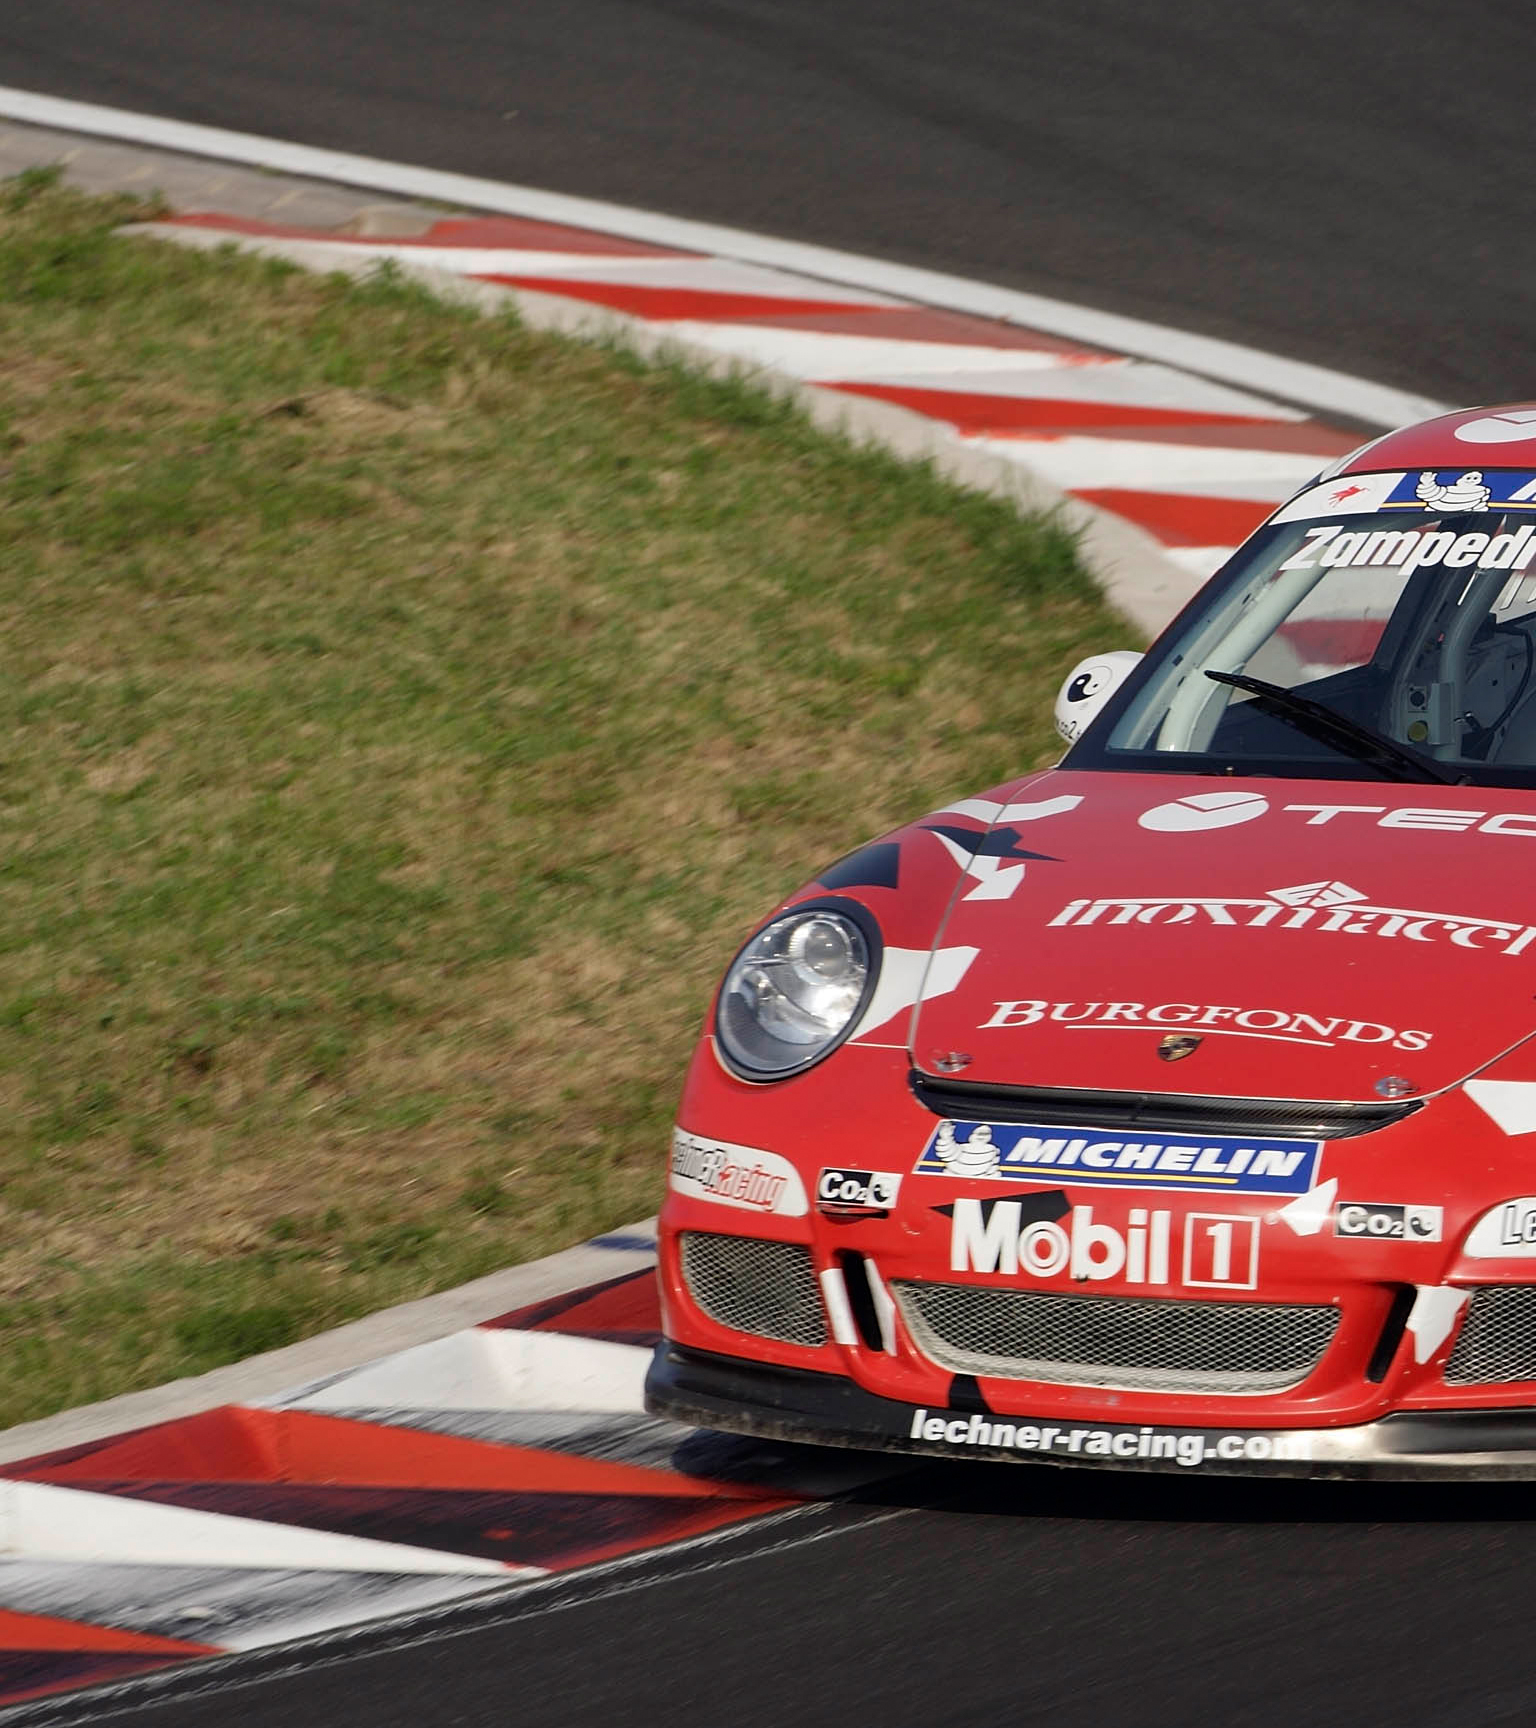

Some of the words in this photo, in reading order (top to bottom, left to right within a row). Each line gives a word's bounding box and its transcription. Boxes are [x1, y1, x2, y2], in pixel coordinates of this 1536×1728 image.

[977, 999, 1434, 1052] BURGFONDS
[1006, 1137, 1308, 1178] MICHELIN
[951, 1200, 1171, 1286] Mobil
[910, 1408, 1313, 1467] lechner-racing.com
